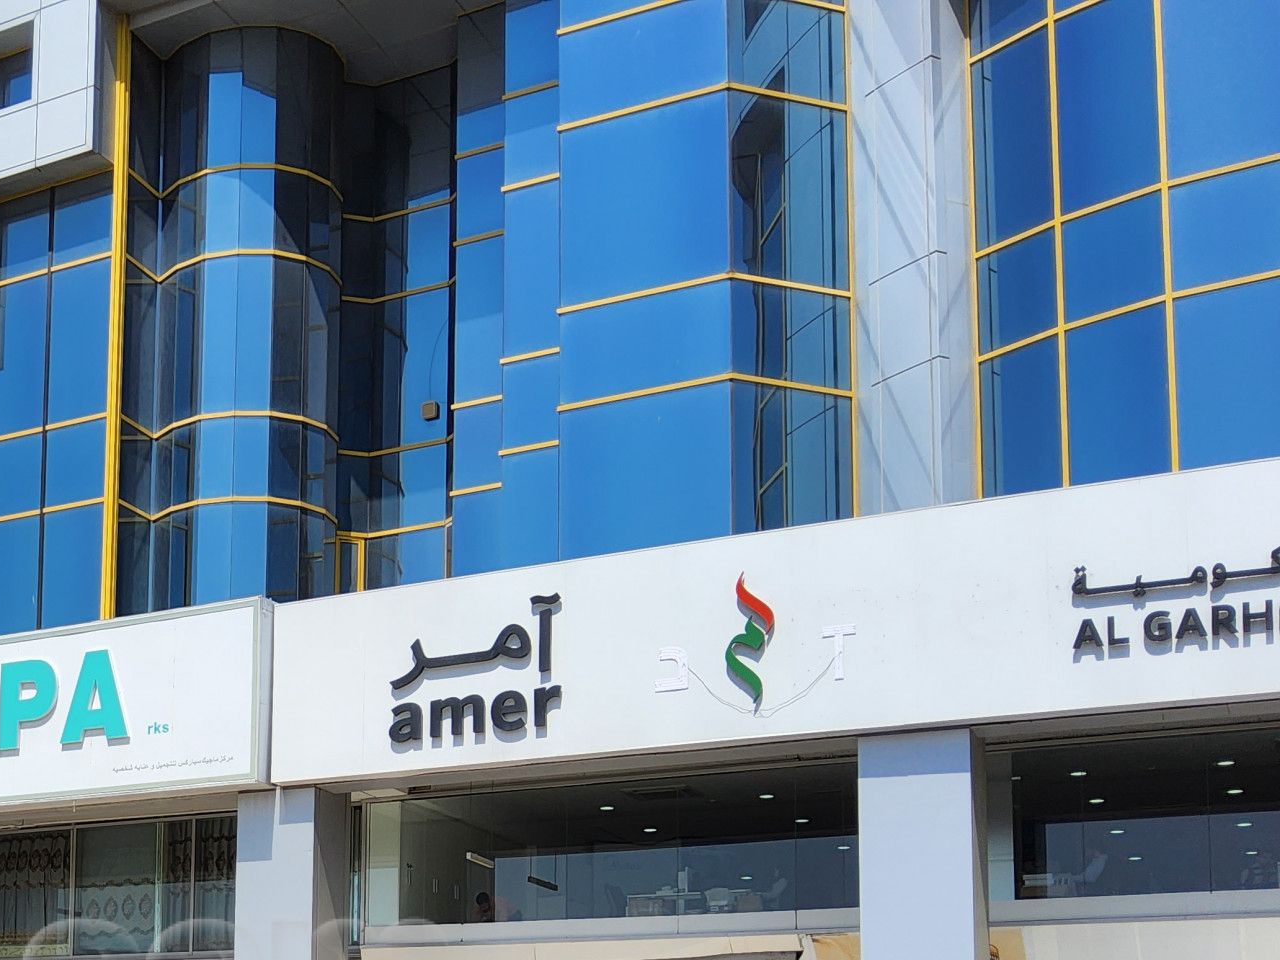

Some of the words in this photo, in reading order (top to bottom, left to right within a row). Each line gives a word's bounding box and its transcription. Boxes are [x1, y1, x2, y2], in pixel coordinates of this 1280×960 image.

[389, 593, 561, 691] آمر
[1073, 616, 1130, 650] AL
[1143, 599, 1280, 642] GARH
[147, 722, 169, 735] rks
[389, 684, 561, 744] amer
